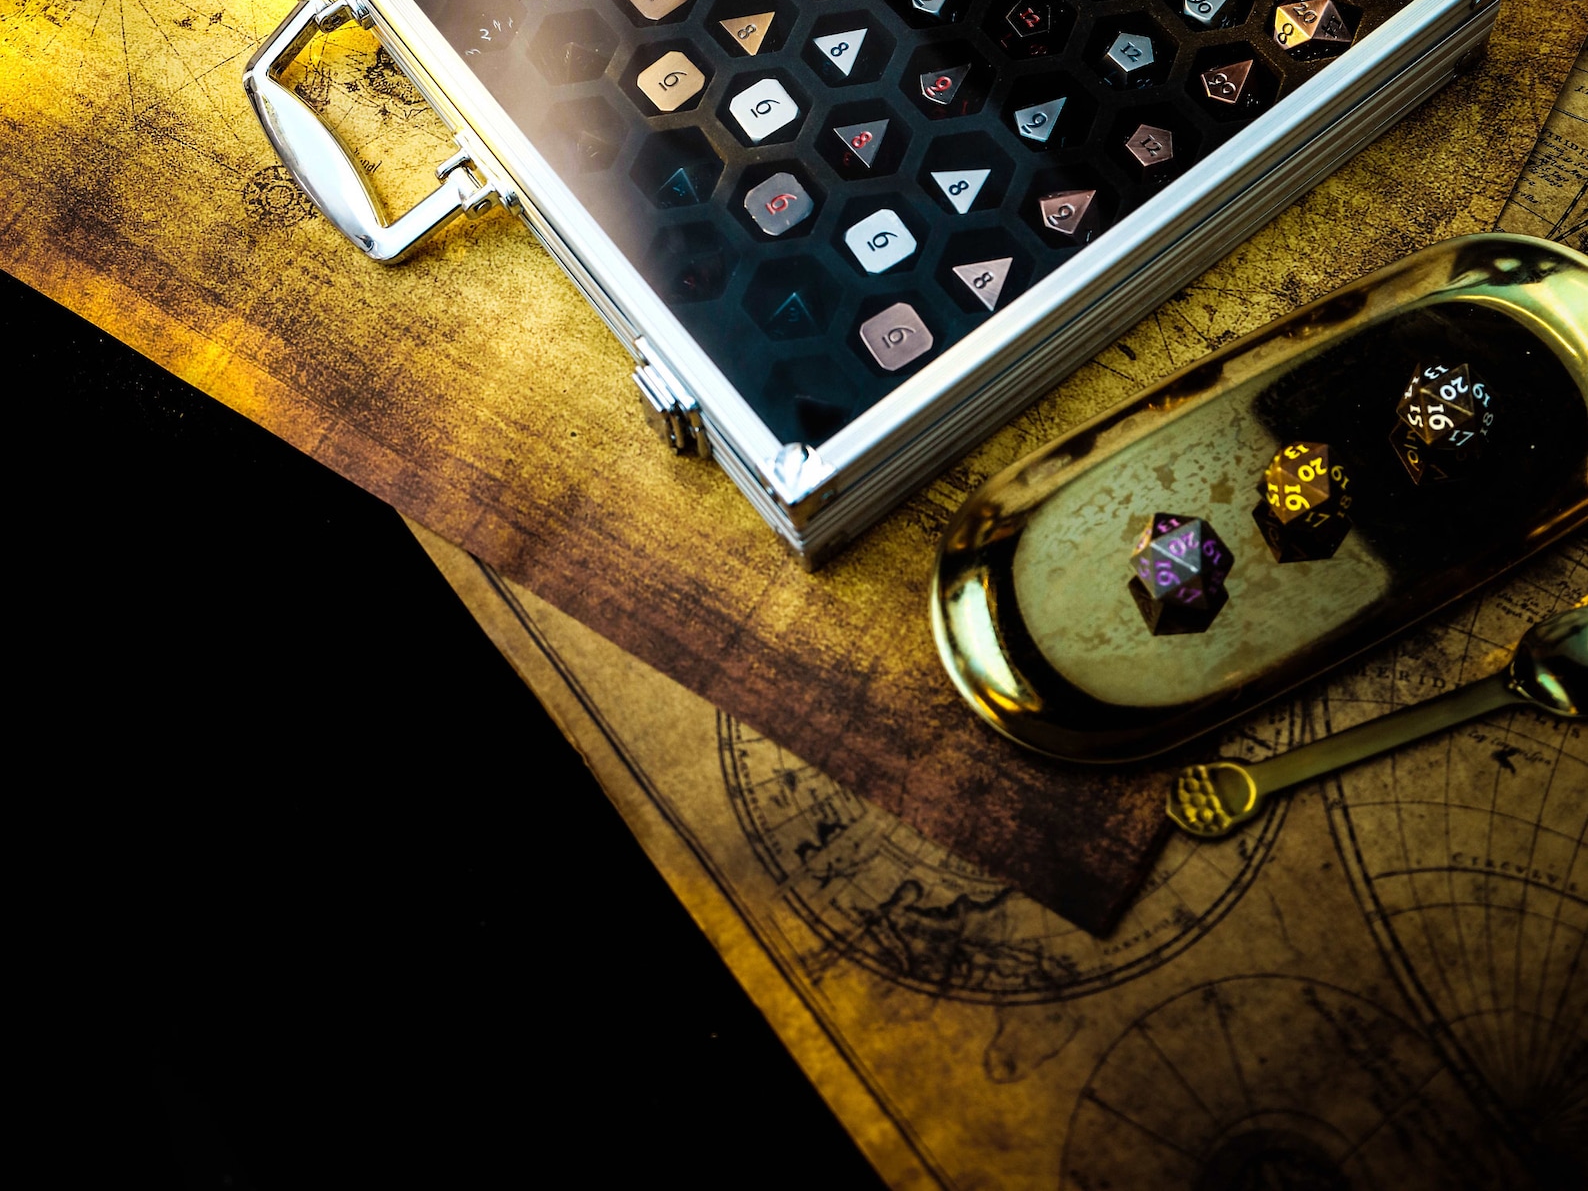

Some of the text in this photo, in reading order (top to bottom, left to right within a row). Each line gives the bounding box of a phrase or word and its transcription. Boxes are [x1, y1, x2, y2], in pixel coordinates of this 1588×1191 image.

[1019, 7, 1041, 28] 12
[1293, 2, 1318, 24] 20
[737, 23, 757, 39] 8
[1277, 23, 1295, 45] 8
[829, 42, 850, 57] 8
[1119, 42, 1142, 63] 12
[658, 71, 688, 91] 6
[750, 99, 781, 118] 6
[1021, 112, 1048, 134] 9
[851, 131, 873, 149] 8
[1140, 134, 1163, 157] 12
[948, 180, 969, 196] 8
[765, 193, 798, 215] 6
[867, 231, 898, 252] 6
[973, 272, 994, 289] 8
[881, 326, 916, 349] 6
[1424, 365, 1449, 380] 13
[1440, 376, 1468, 401] 20
[1407, 404, 1423, 428] 15
[1427, 404, 1454, 430] 16
[1448, 429, 1475, 446] 17
[1284, 444, 1310, 460] 13
[1297, 457, 1327, 482] 20
[1284, 484, 1310, 511] 16
[1305, 511, 1331, 528] 17
[1169, 531, 1199, 557] 20
[1154, 560, 1181, 586] 16
